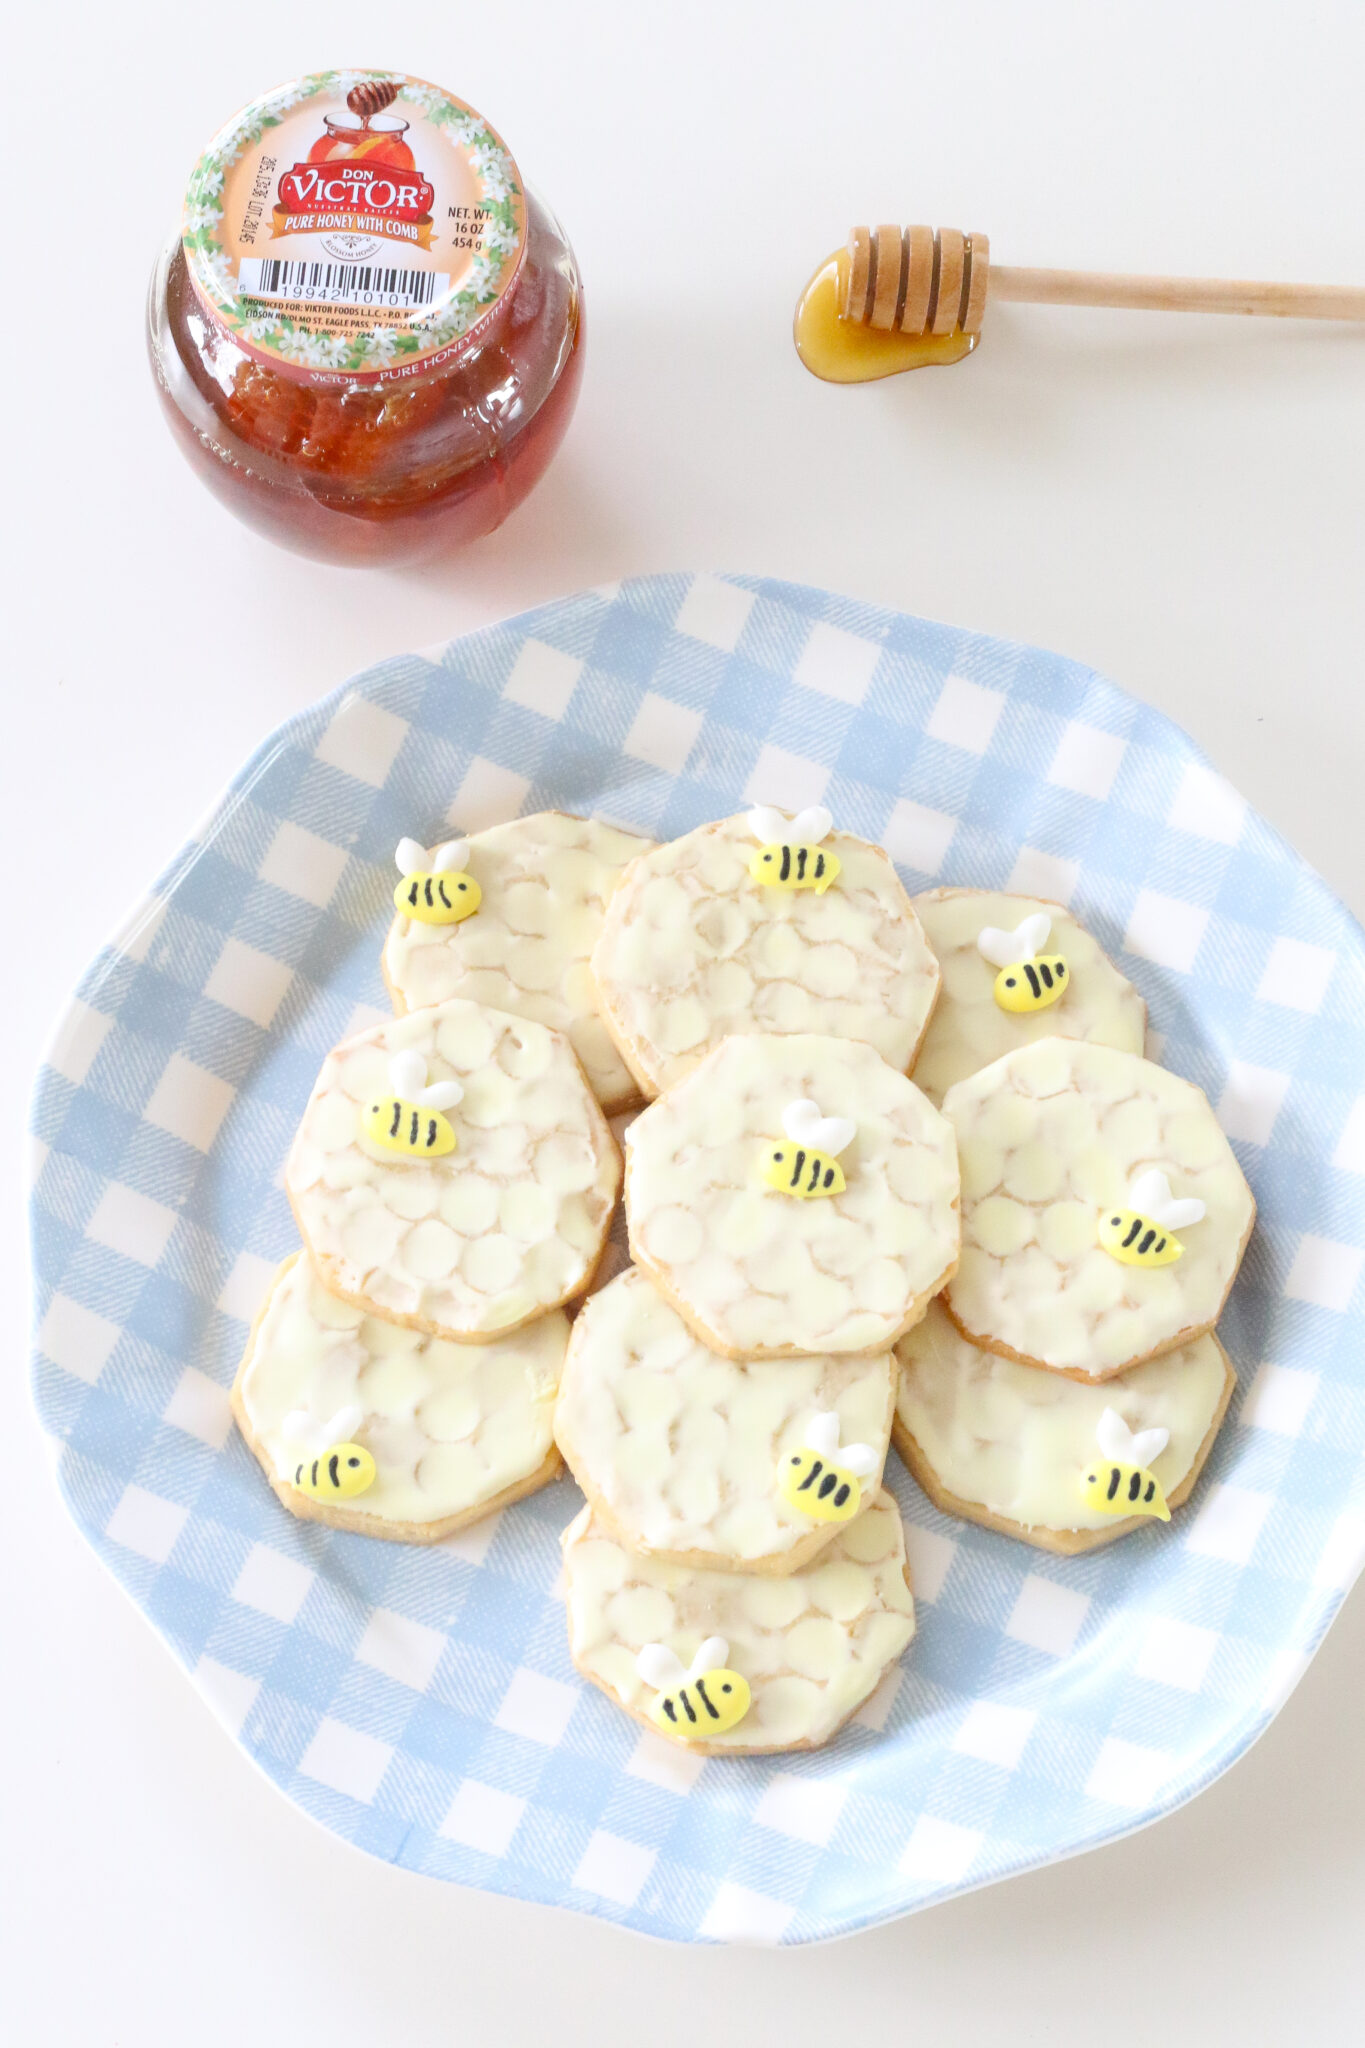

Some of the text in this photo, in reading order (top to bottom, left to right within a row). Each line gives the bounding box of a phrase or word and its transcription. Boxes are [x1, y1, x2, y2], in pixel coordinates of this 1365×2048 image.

[342, 168, 374, 181] DON
[291, 168, 419, 209] VICTOR
[448, 206, 493, 220] NET. WT.
[284, 213, 419, 241] PURE HONEY WITH COMB
[456, 222, 485, 235] 16 OZ
[452, 237, 482, 252] 454 g
[281, 286, 341, 301] 19942
[353, 291, 409, 306] 10101
[242, 297, 284, 310] PRODUCED
[285, 303, 303, 312] FOR:
[304, 304, 333, 314] VIKTOR
[334, 306, 359, 316] FOODS
[245, 308, 274, 319] EIDSON
[313, 317, 324, 325] ST.
[325, 318, 349, 327] EAGLE
[380, 364, 420, 381] PURE
[424, 332, 472, 370] HONEY
